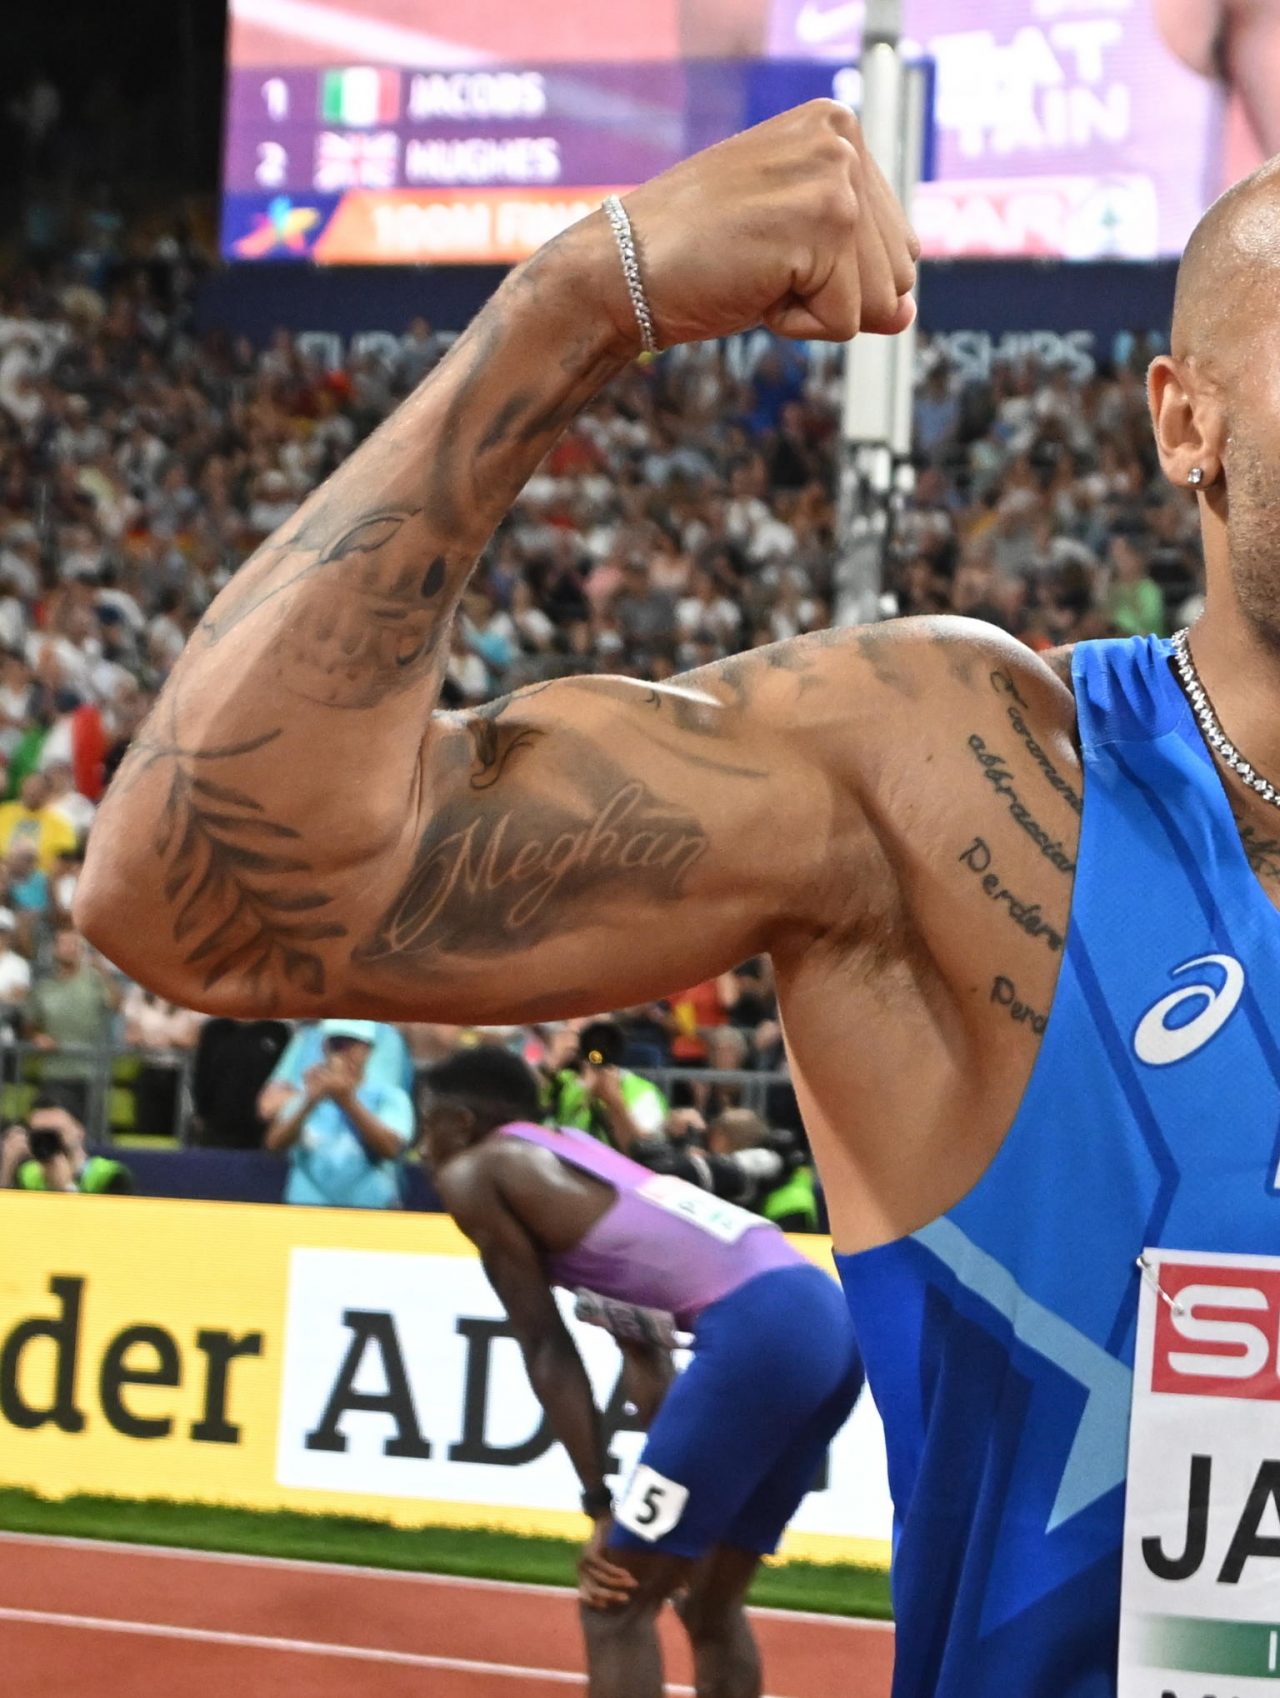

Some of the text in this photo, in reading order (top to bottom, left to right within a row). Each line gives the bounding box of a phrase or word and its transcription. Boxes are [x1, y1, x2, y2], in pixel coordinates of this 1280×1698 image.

[261, 71, 547, 122] 1 JACOBS
[254, 137, 561, 188] 2 HUGHES
[365, 777, 710, 961] Meghan
[1, 1275, 262, 1445] der
[636, 1486, 665, 1525] 5
[1267, 1630, 1279, 1673] I
